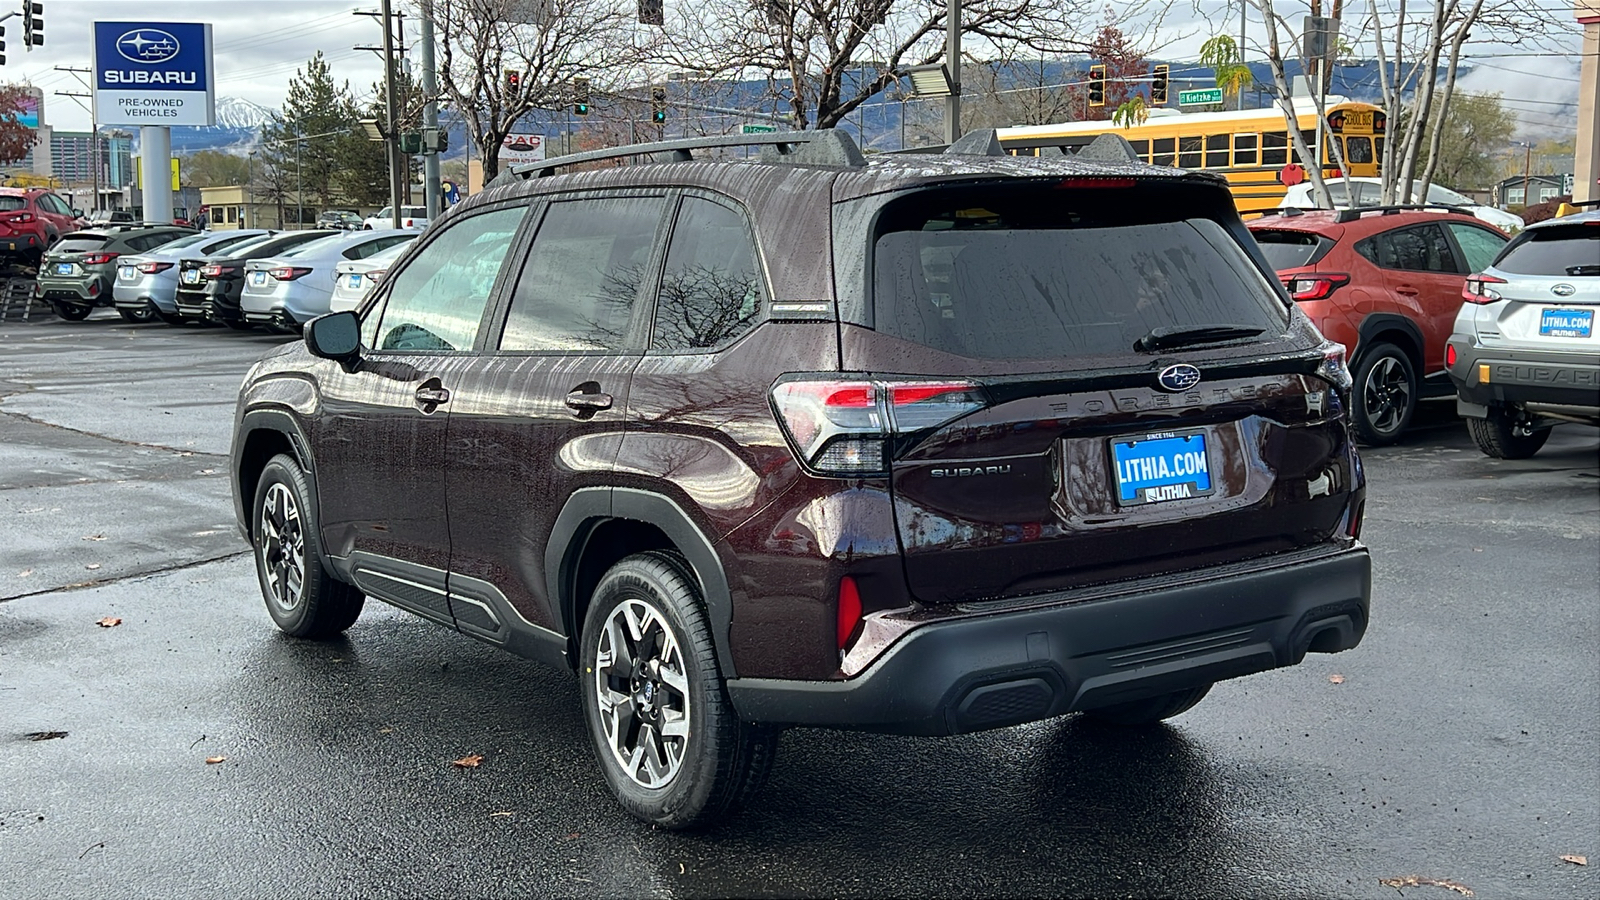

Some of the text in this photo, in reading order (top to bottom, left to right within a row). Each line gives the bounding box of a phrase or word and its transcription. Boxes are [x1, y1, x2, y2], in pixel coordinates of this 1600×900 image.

[104, 70, 196, 84] SUBARU
[118, 98, 184, 107] PRE-OWNED
[1186, 93, 1211, 103] Kietzke
[125, 109, 178, 117] VEHICLES
[1345, 113, 1372, 126] SCHOOL BUS
[1541, 316, 1591, 329] LITHIA.COM
[1048, 382, 1283, 412] FORESTER
[1146, 433, 1163, 441] SINCE
[930, 464, 1011, 478] SUBARU
[1116, 450, 1208, 484] LITHIA.COM
[1155, 483, 1192, 501] LITHIA
